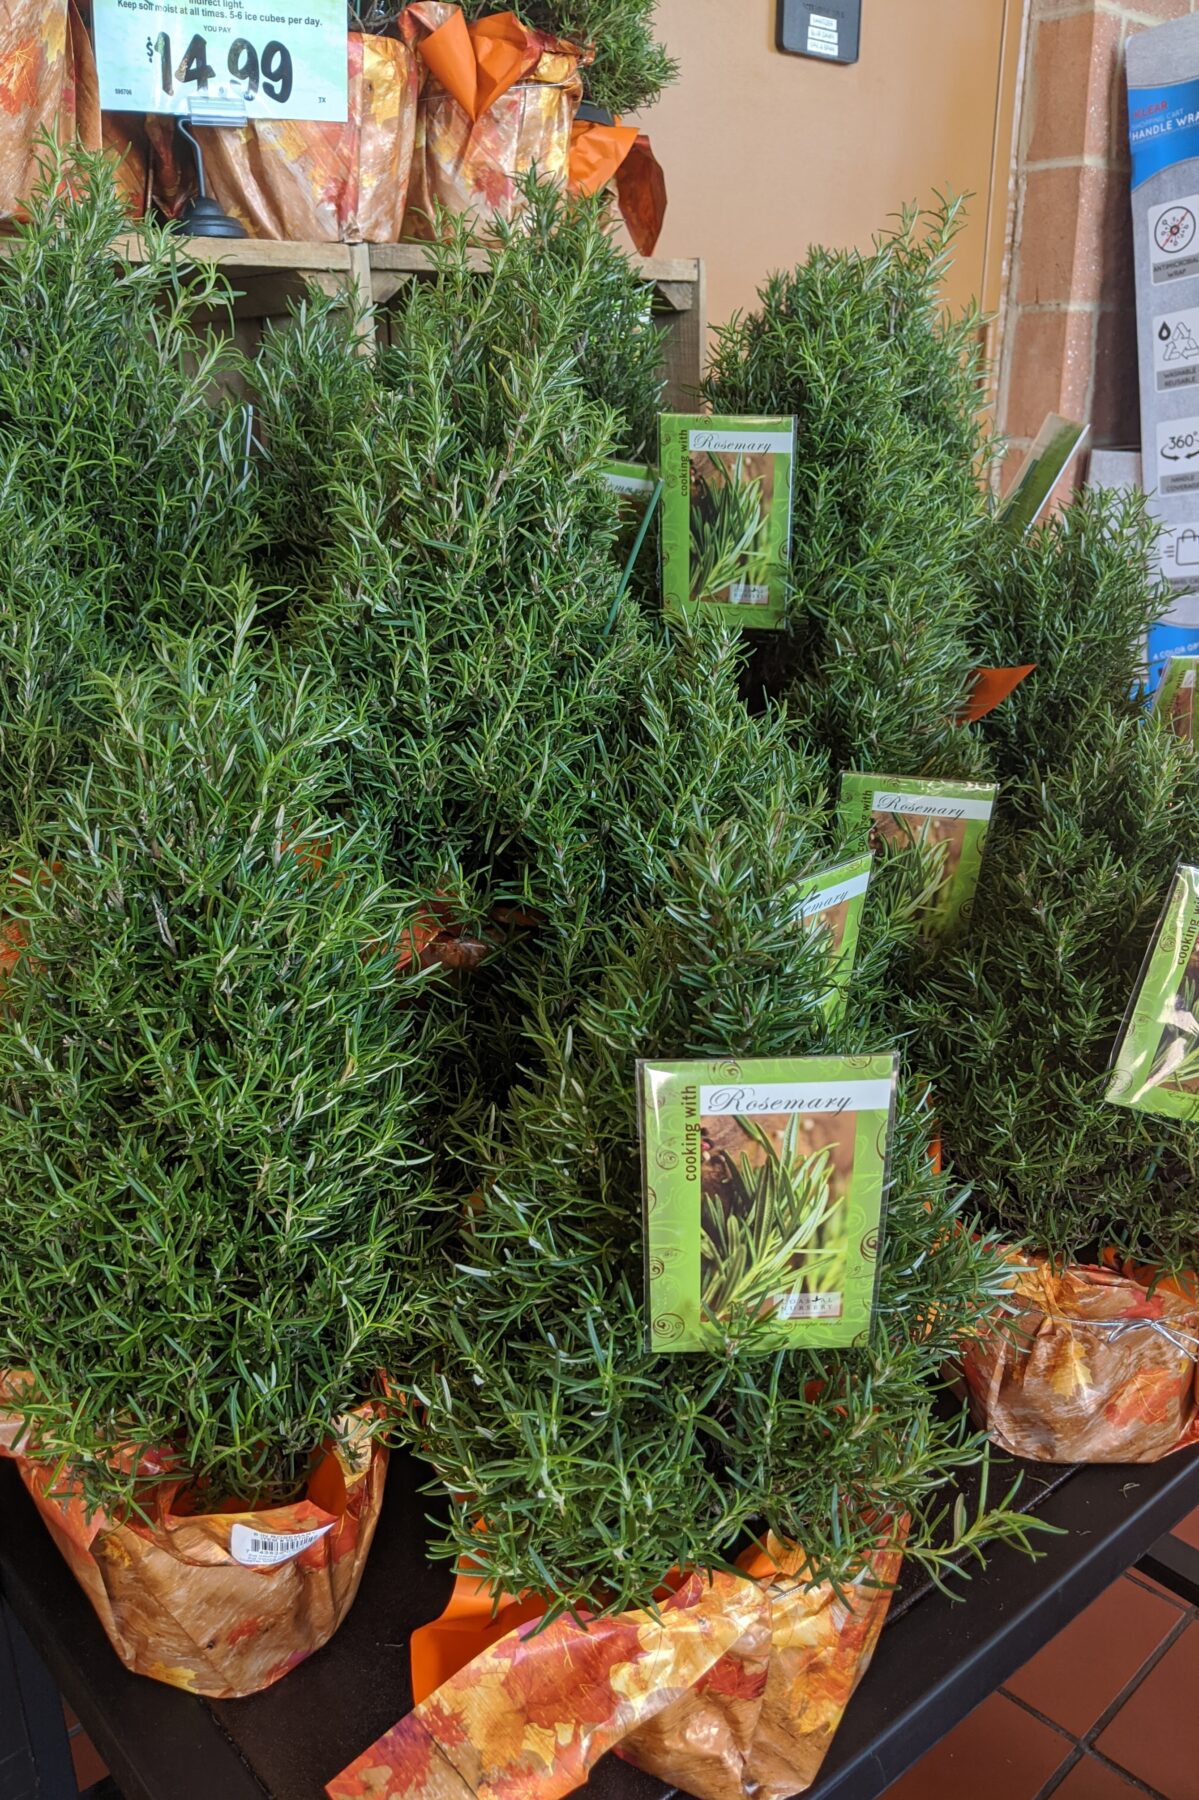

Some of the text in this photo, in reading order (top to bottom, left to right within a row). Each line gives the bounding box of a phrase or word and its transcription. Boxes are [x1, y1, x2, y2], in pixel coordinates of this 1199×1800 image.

[117, 0, 137, 10] Keep
[155, 4, 178, 14] moist
[180, 7, 188, 15] at
[190, 8, 199, 16] all
[202, 9, 227, 19] times.
[230, 11, 242, 19] 5-6
[245, 12, 257, 21] ice
[260, 14, 285, 23] cubes
[288, 17, 302, 26] per
[304, 17, 322, 27] day.
[1131, 120, 1173, 141] HANDLE
[693, 433, 772, 456] Rosemary
[679, 429, 689, 497] cooking with
[862, 790, 872, 811] with
[877, 794, 965, 821] Rosemary
[1177, 918, 1199, 966] cooking
[708, 1087, 852, 1117] Rosemary
[681, 1085, 701, 1182] cooking with
